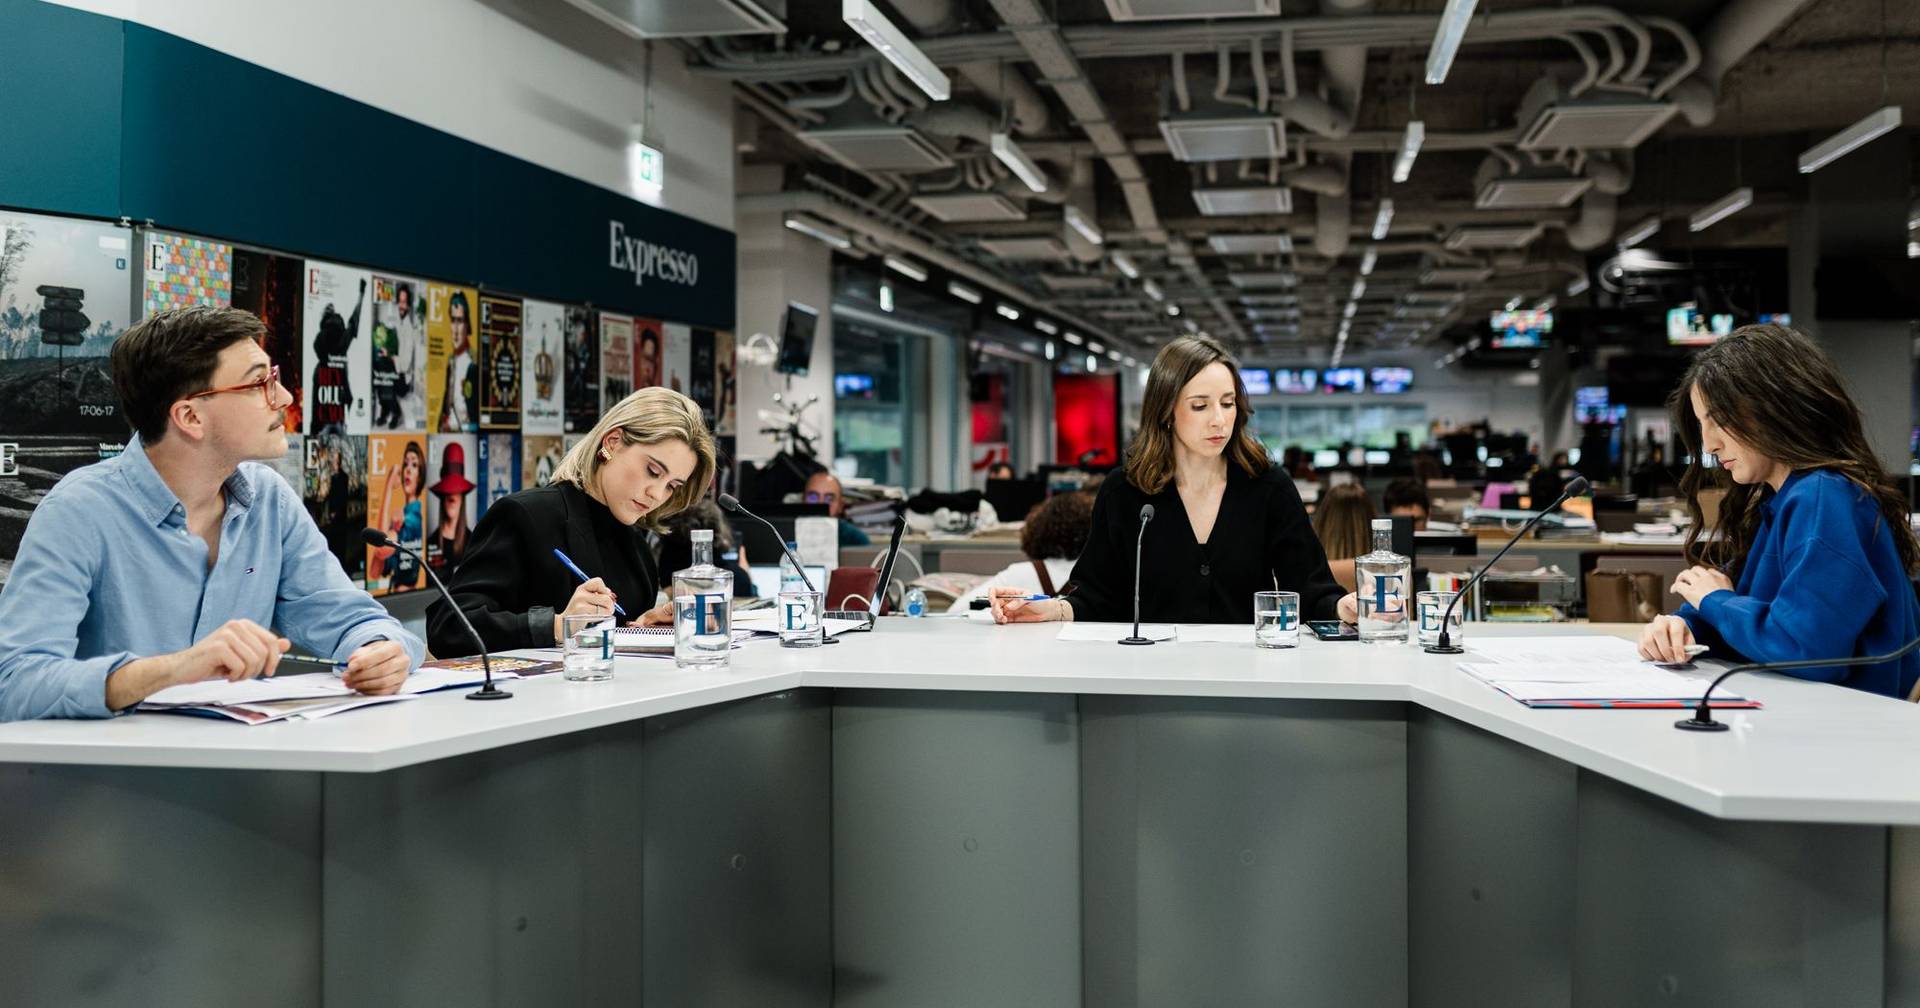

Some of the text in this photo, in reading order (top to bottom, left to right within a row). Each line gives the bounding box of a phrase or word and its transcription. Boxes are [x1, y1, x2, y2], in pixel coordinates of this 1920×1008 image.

[151, 244, 164, 271] E
[609, 219, 698, 286] Expresso
[309, 269, 320, 295] E
[430, 287, 443, 322] E
[80, 405, 114, 416] 17-06-17
[0, 443, 19, 476] E
[306, 439, 320, 470] E
[371, 438, 388, 476] E
[1374, 575, 1403, 613] E
[695, 593, 727, 635] E
[786, 603, 807, 631] E
[1279, 604, 1297, 632] E
[1420, 603, 1440, 631] E
